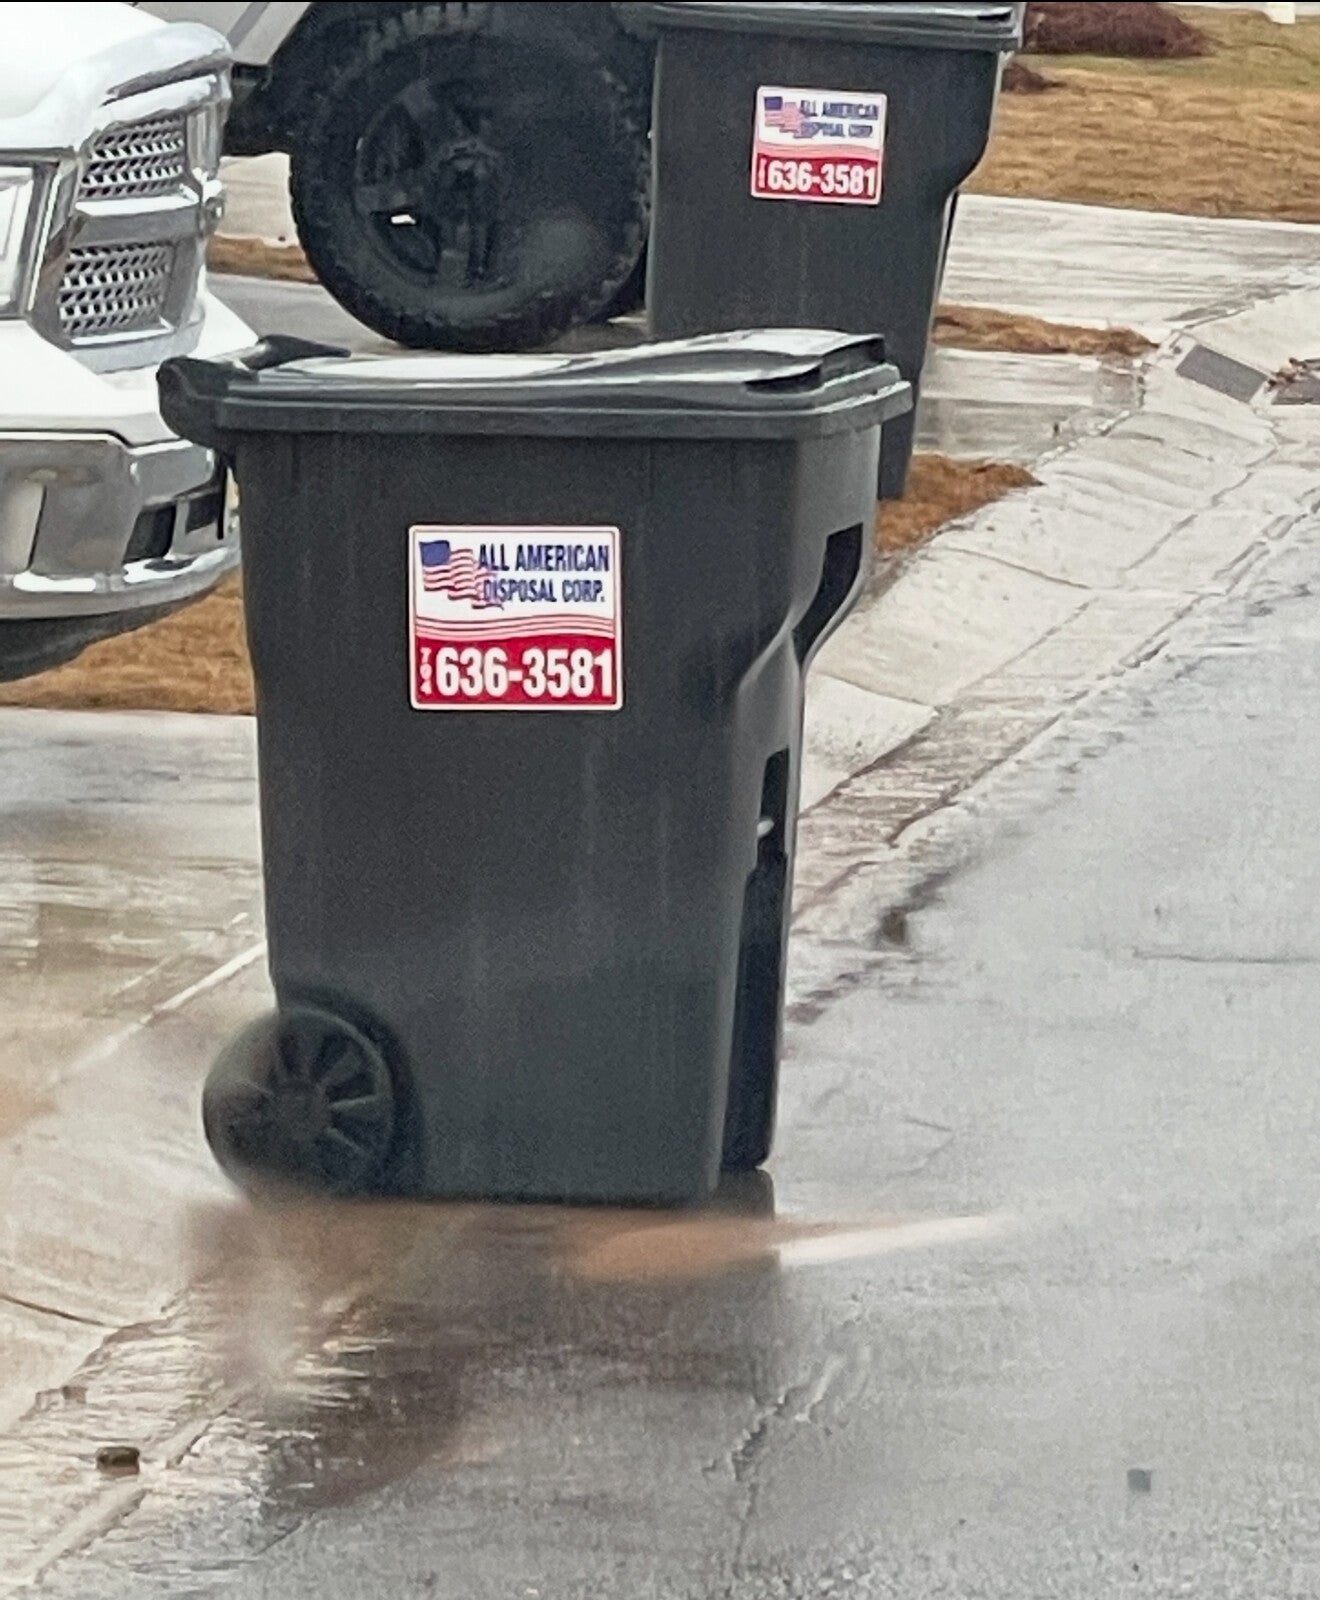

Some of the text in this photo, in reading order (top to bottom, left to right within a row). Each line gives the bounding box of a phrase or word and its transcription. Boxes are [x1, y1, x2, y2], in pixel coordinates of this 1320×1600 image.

[767, 160, 876, 196] 636-3581
[478, 543, 610, 572] ALL AMERICAN
[483, 578, 605, 603] DISPOSAL CORP.
[436, 647, 613, 698] 636-3581
